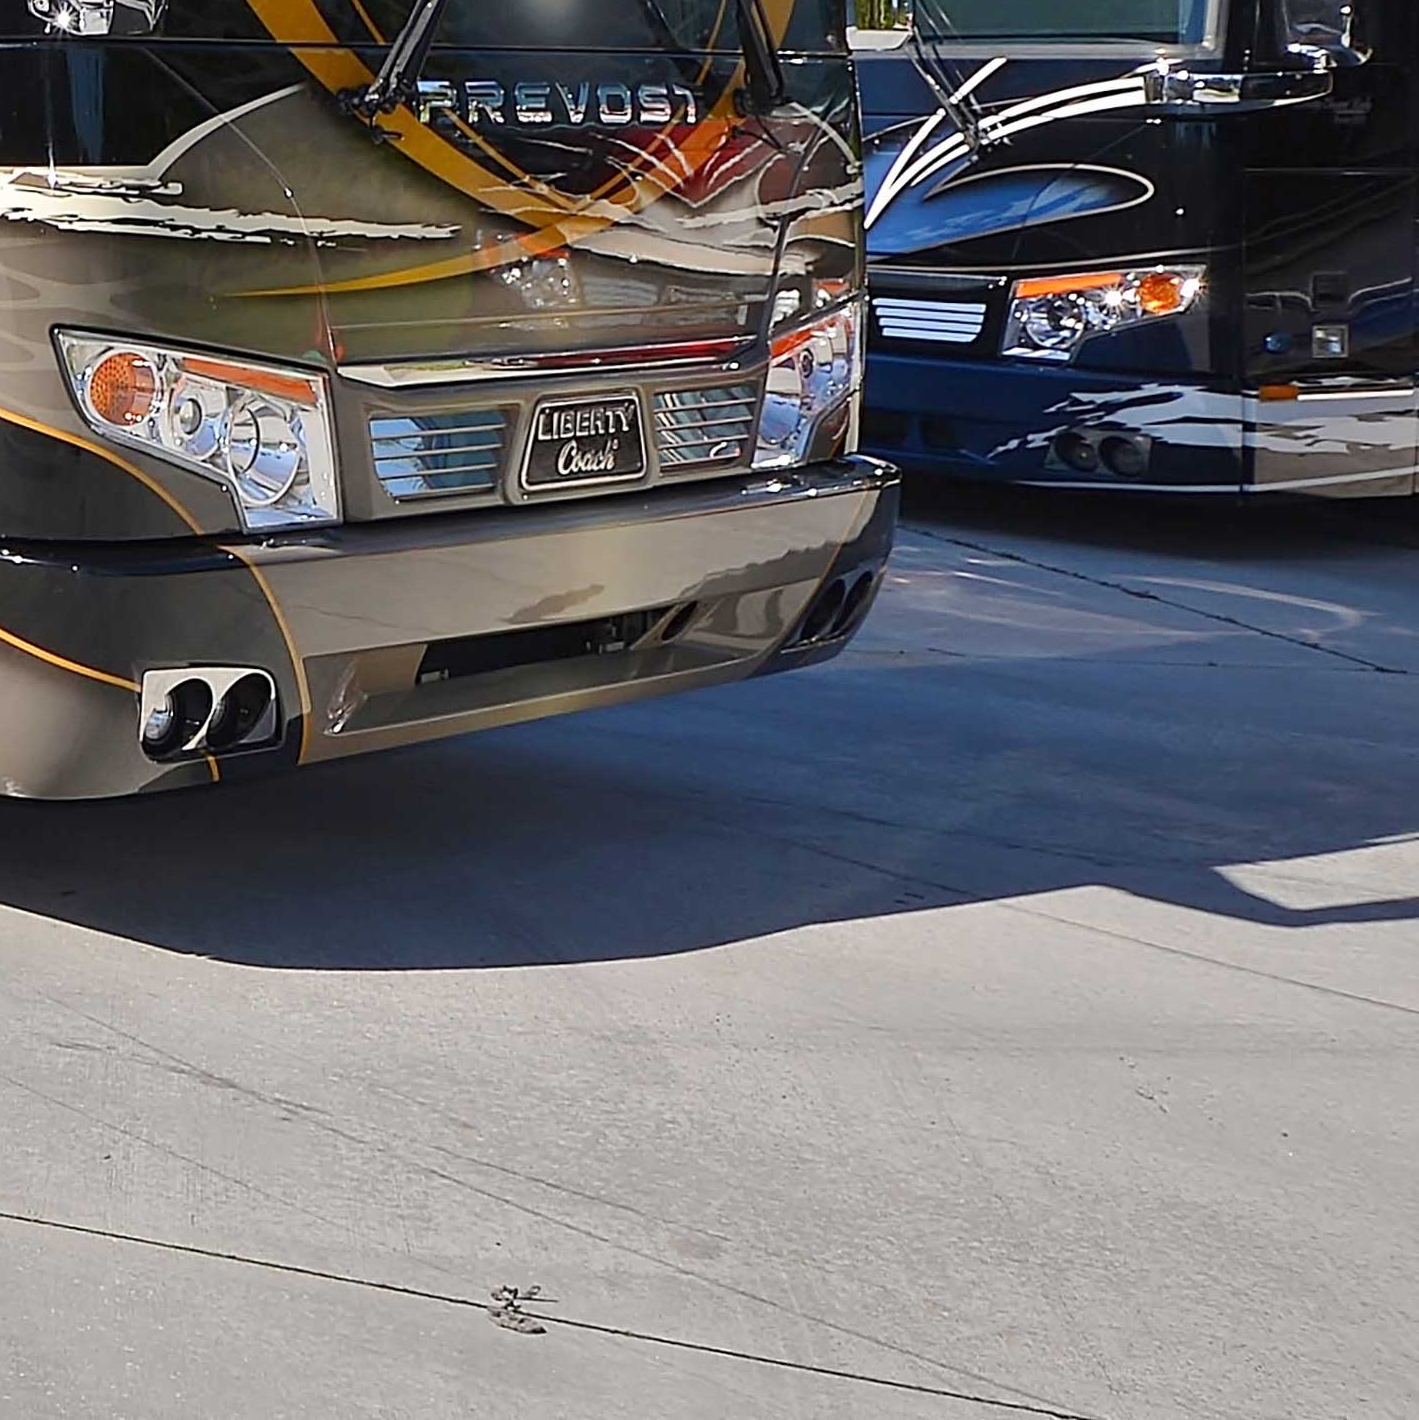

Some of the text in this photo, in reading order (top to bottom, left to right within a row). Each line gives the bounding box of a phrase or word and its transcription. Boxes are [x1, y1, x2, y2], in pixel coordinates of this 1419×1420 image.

[415, 80, 697, 124] PREVOST
[537, 402, 636, 441] LIBERTY
[557, 439, 615, 475] Coach
